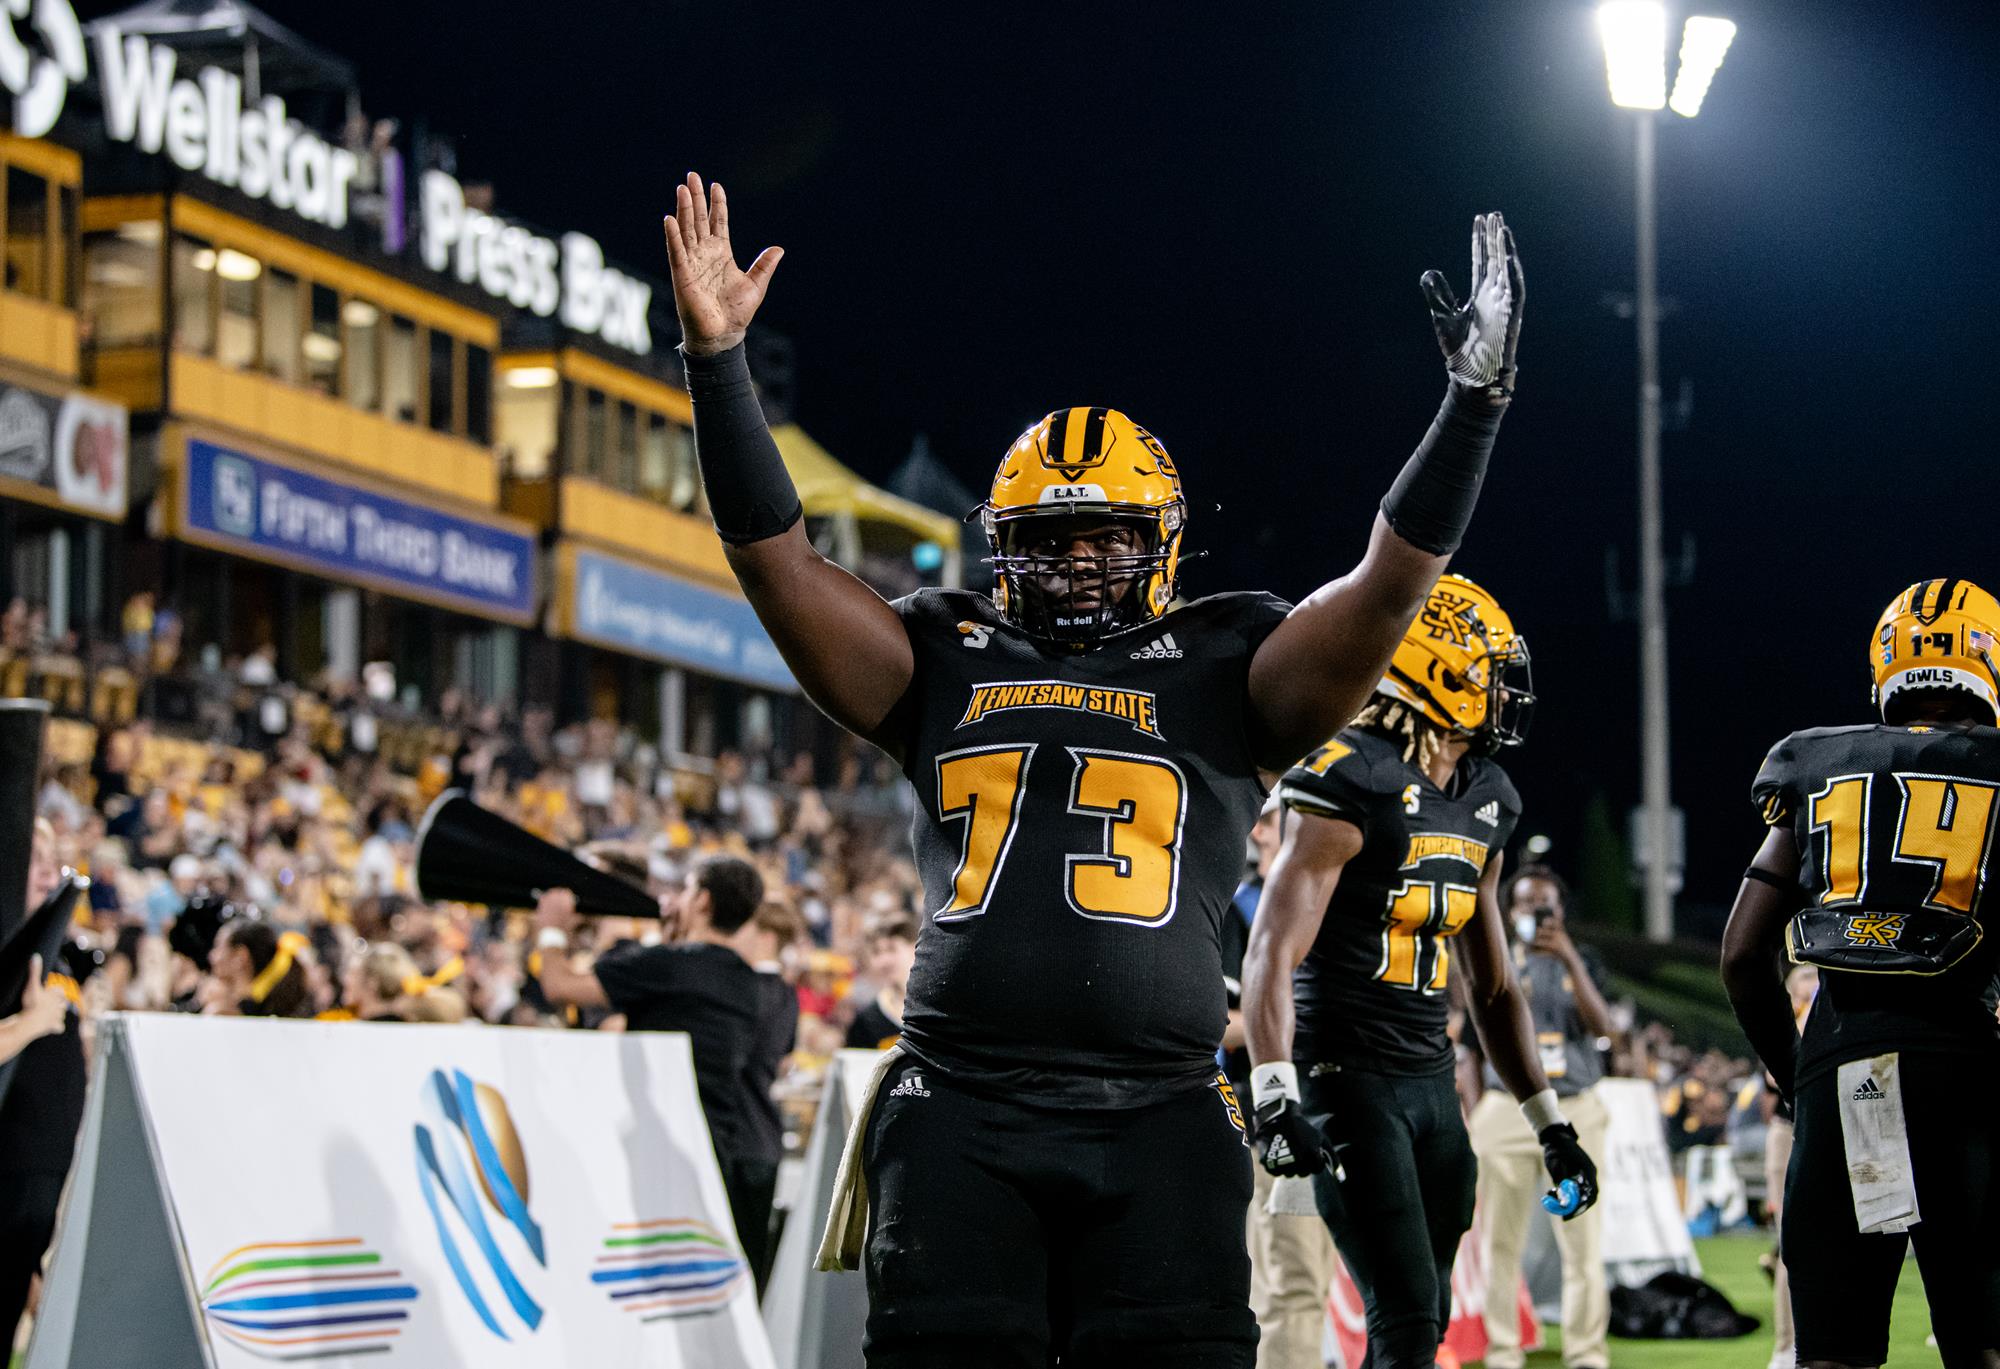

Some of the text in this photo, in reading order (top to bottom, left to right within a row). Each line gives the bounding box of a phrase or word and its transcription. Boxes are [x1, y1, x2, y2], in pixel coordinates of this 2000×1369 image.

[98, 23, 652, 355] Wellstar Press Box
[1053, 487, 1088, 498] E.A.T.
[1130, 648, 1184, 660] adidas
[1905, 669, 1953, 684] OWLS
[963, 684, 1154, 732] KENNESAW STATE
[933, 743, 1188, 928] 73
[1809, 772, 2000, 916] 14
[890, 1086, 931, 1098] adidas
[1853, 1091, 1885, 1101] adidas
